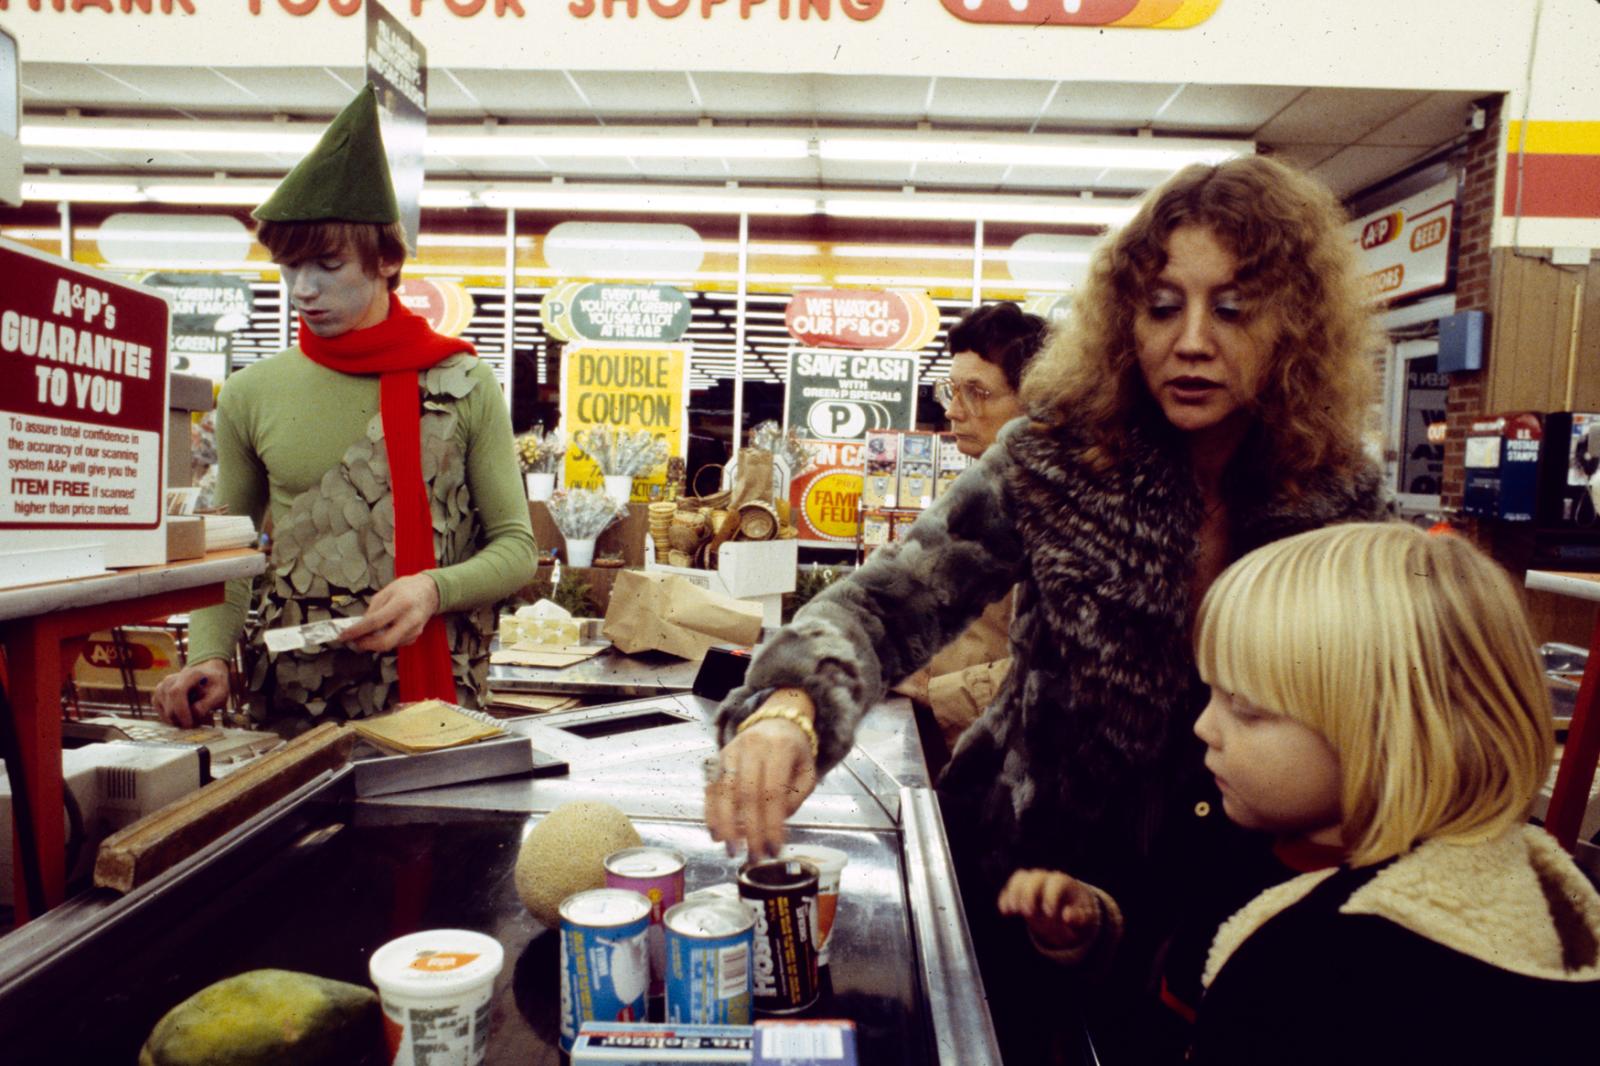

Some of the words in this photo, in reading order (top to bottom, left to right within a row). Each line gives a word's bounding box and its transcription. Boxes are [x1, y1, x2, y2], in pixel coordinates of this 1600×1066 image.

[53, 278, 116, 330] A&P's
[806, 297, 832, 316] WE
[833, 299, 888, 318] WATCH
[792, 315, 832, 335] OUR
[1, 310, 151, 380] GUARANTEE
[578, 354, 668, 388] DOUBLE
[797, 354, 847, 378] SAVE
[851, 356, 909, 381] CASH
[35, 365, 68, 406] TO
[73, 372, 122, 415] YOU
[802, 387, 840, 398] GREEN
[849, 389, 902, 402] SPECIALS
[838, 379, 868, 389] WITH
[576, 392, 671, 427] COUPON
[828, 405, 851, 434] P
[9, 417, 22, 431] To
[25, 422, 58, 436] assure
[60, 424, 81, 439] total
[83, 428, 130, 444] confidence
[131, 434, 139, 445] in
[8, 437, 24, 450] the
[27, 440, 72, 457] accuracy
[74, 445, 83, 456] of
[85, 447, 100, 457] our
[102, 449, 139, 463] scanning
[1506, 451, 1538, 462] STAMPS
[8, 458, 45, 472] system
[48, 459, 67, 473] A&P
[70, 462, 85, 474] will
[88, 463, 105, 477] give
[108, 466, 122, 478] you
[125, 466, 137, 477] the
[11, 478, 49, 495] ITEM
[53, 480, 90, 497] FREE
[100, 487, 136, 499] scanned
[14, 501, 46, 516] higher
[49, 501, 70, 514] than
[72, 504, 95, 516] price
